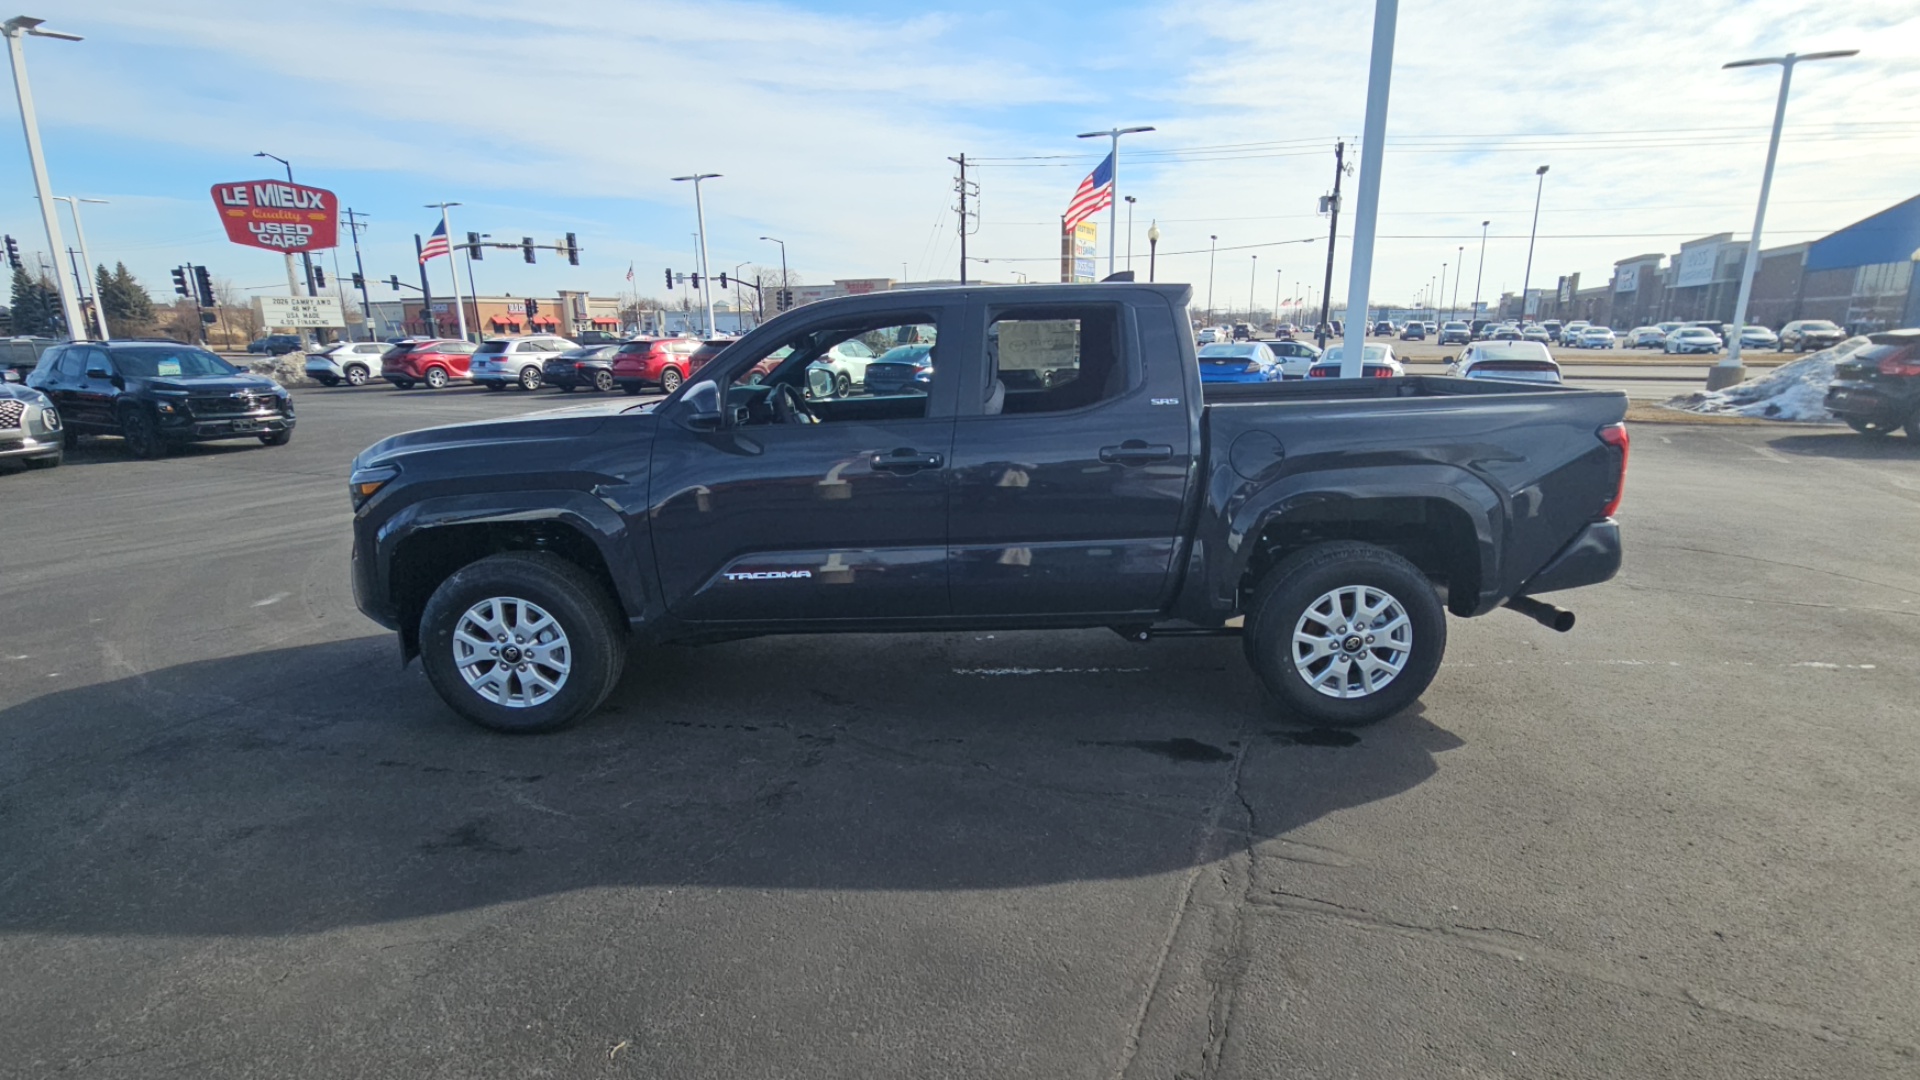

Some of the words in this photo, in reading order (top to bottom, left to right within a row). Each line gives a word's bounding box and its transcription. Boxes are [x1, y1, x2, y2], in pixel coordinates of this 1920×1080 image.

[220, 186, 249, 206] LE
[253, 183, 326, 210] MIEUX
[251, 208, 302, 223] Quality
[248, 221, 313, 236] USED
[257, 233, 309, 249] CARS
[723, 570, 812, 581] TACOMA
